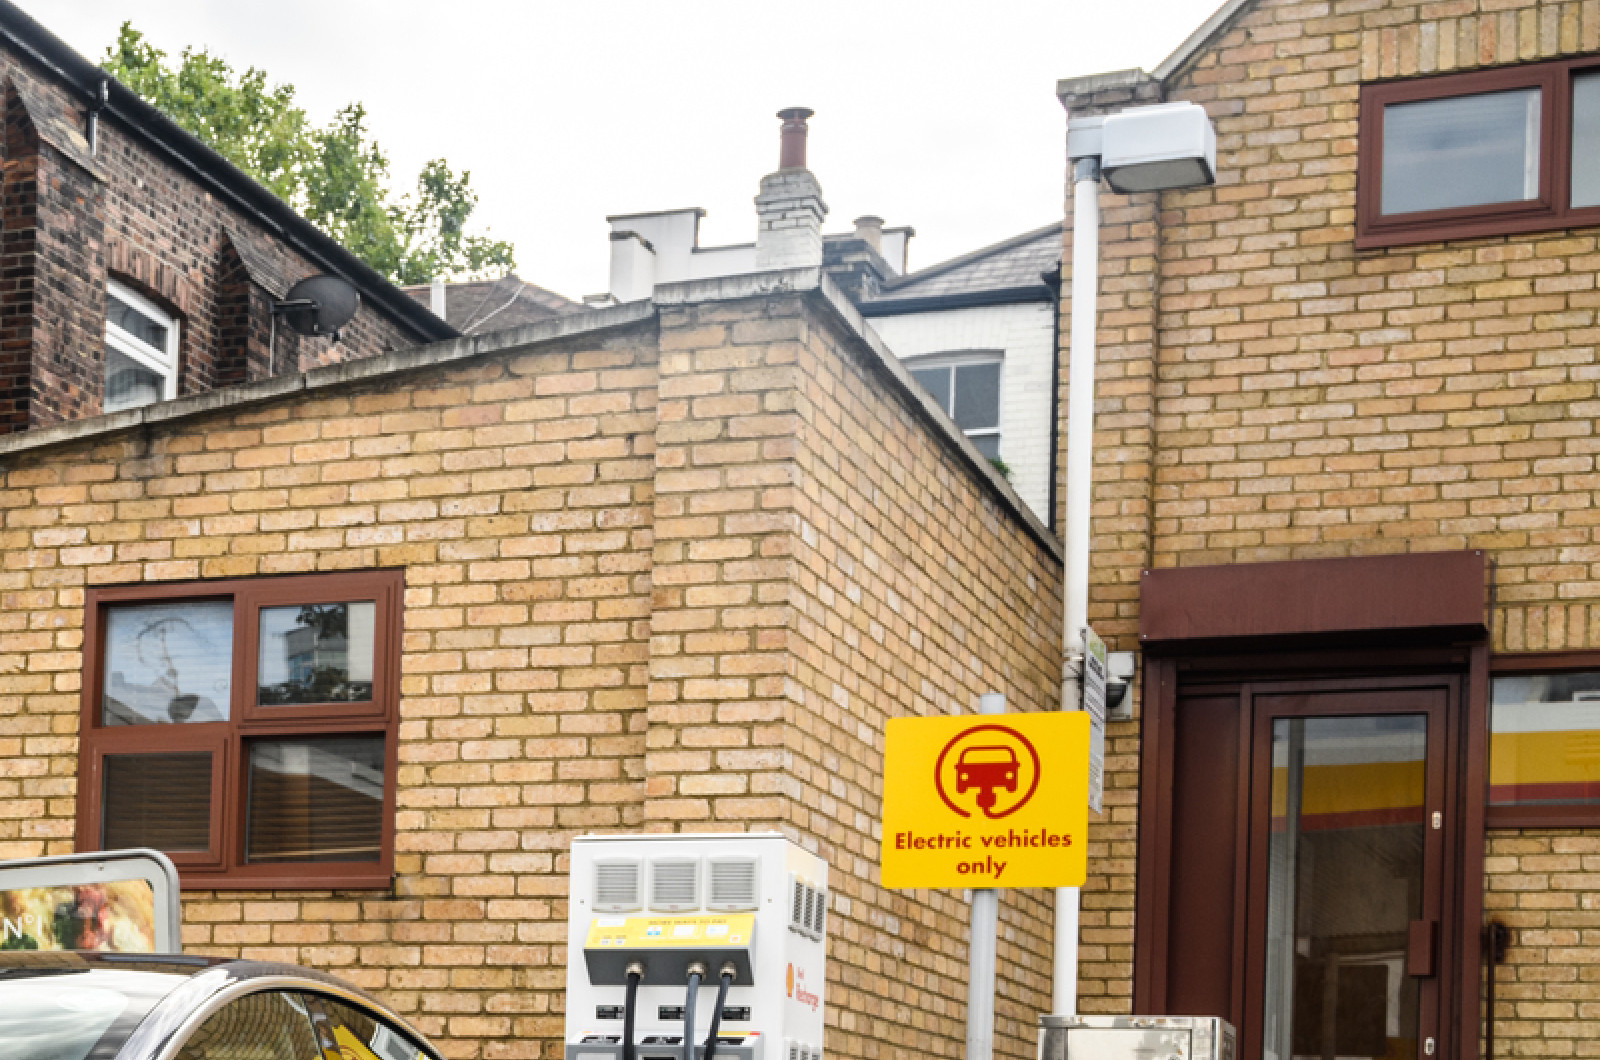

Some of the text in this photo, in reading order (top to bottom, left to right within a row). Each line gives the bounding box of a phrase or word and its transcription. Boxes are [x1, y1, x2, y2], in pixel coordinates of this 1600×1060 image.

[895, 827, 1073, 850] Electric vehicles
[956, 855, 1007, 880] only
